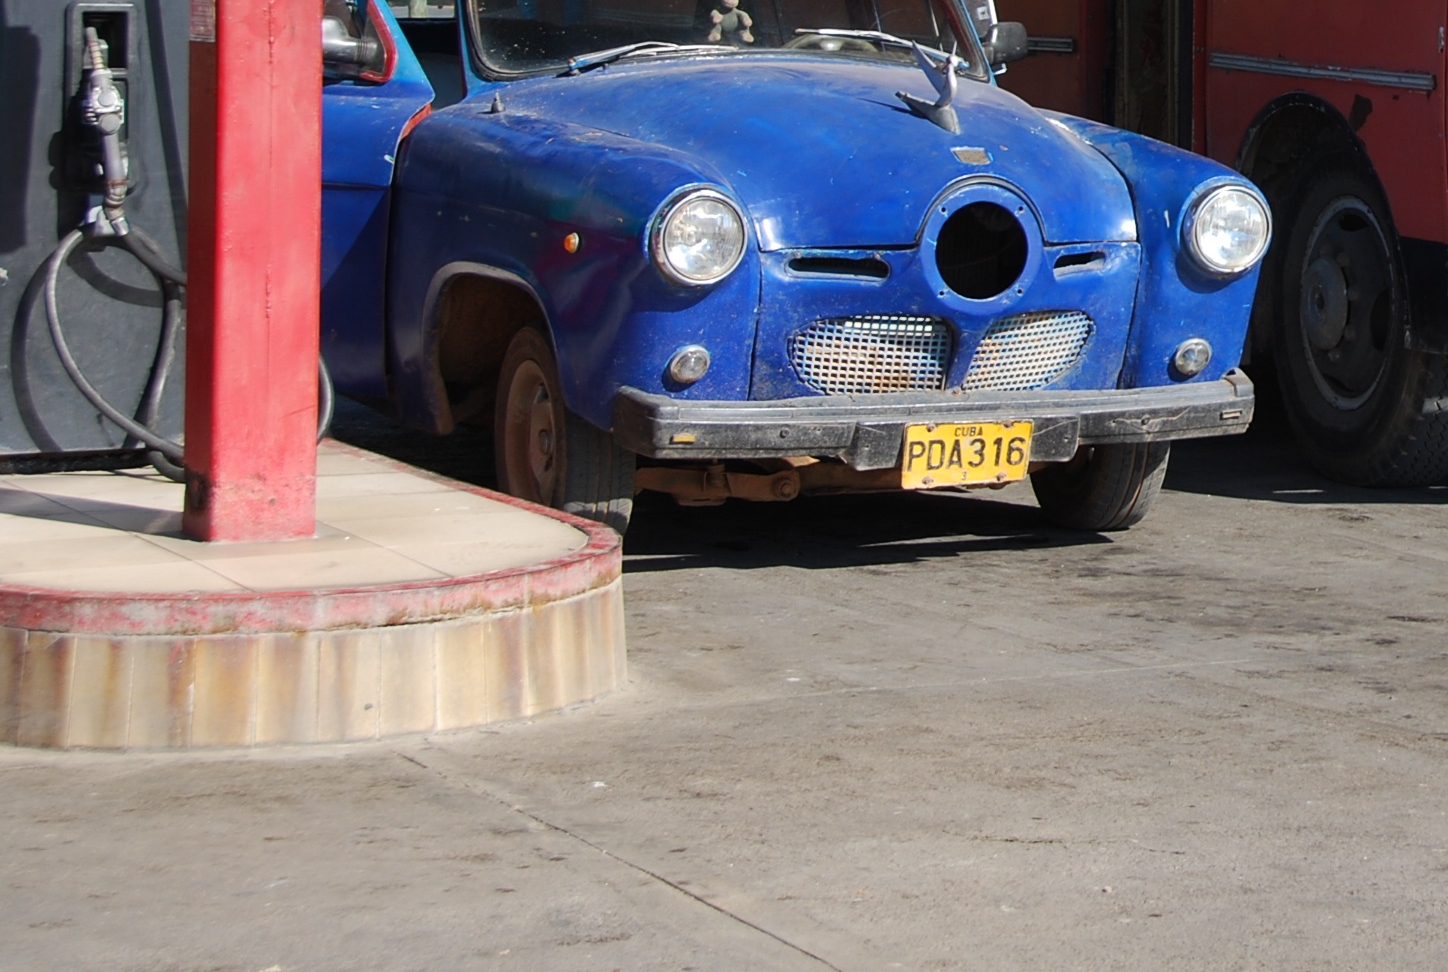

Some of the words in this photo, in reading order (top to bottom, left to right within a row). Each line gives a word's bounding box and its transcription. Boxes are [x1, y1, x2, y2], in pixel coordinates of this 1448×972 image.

[954, 426, 984, 437] CUBA
[907, 436, 1027, 472] PDA316
[961, 471, 967, 481] 3
